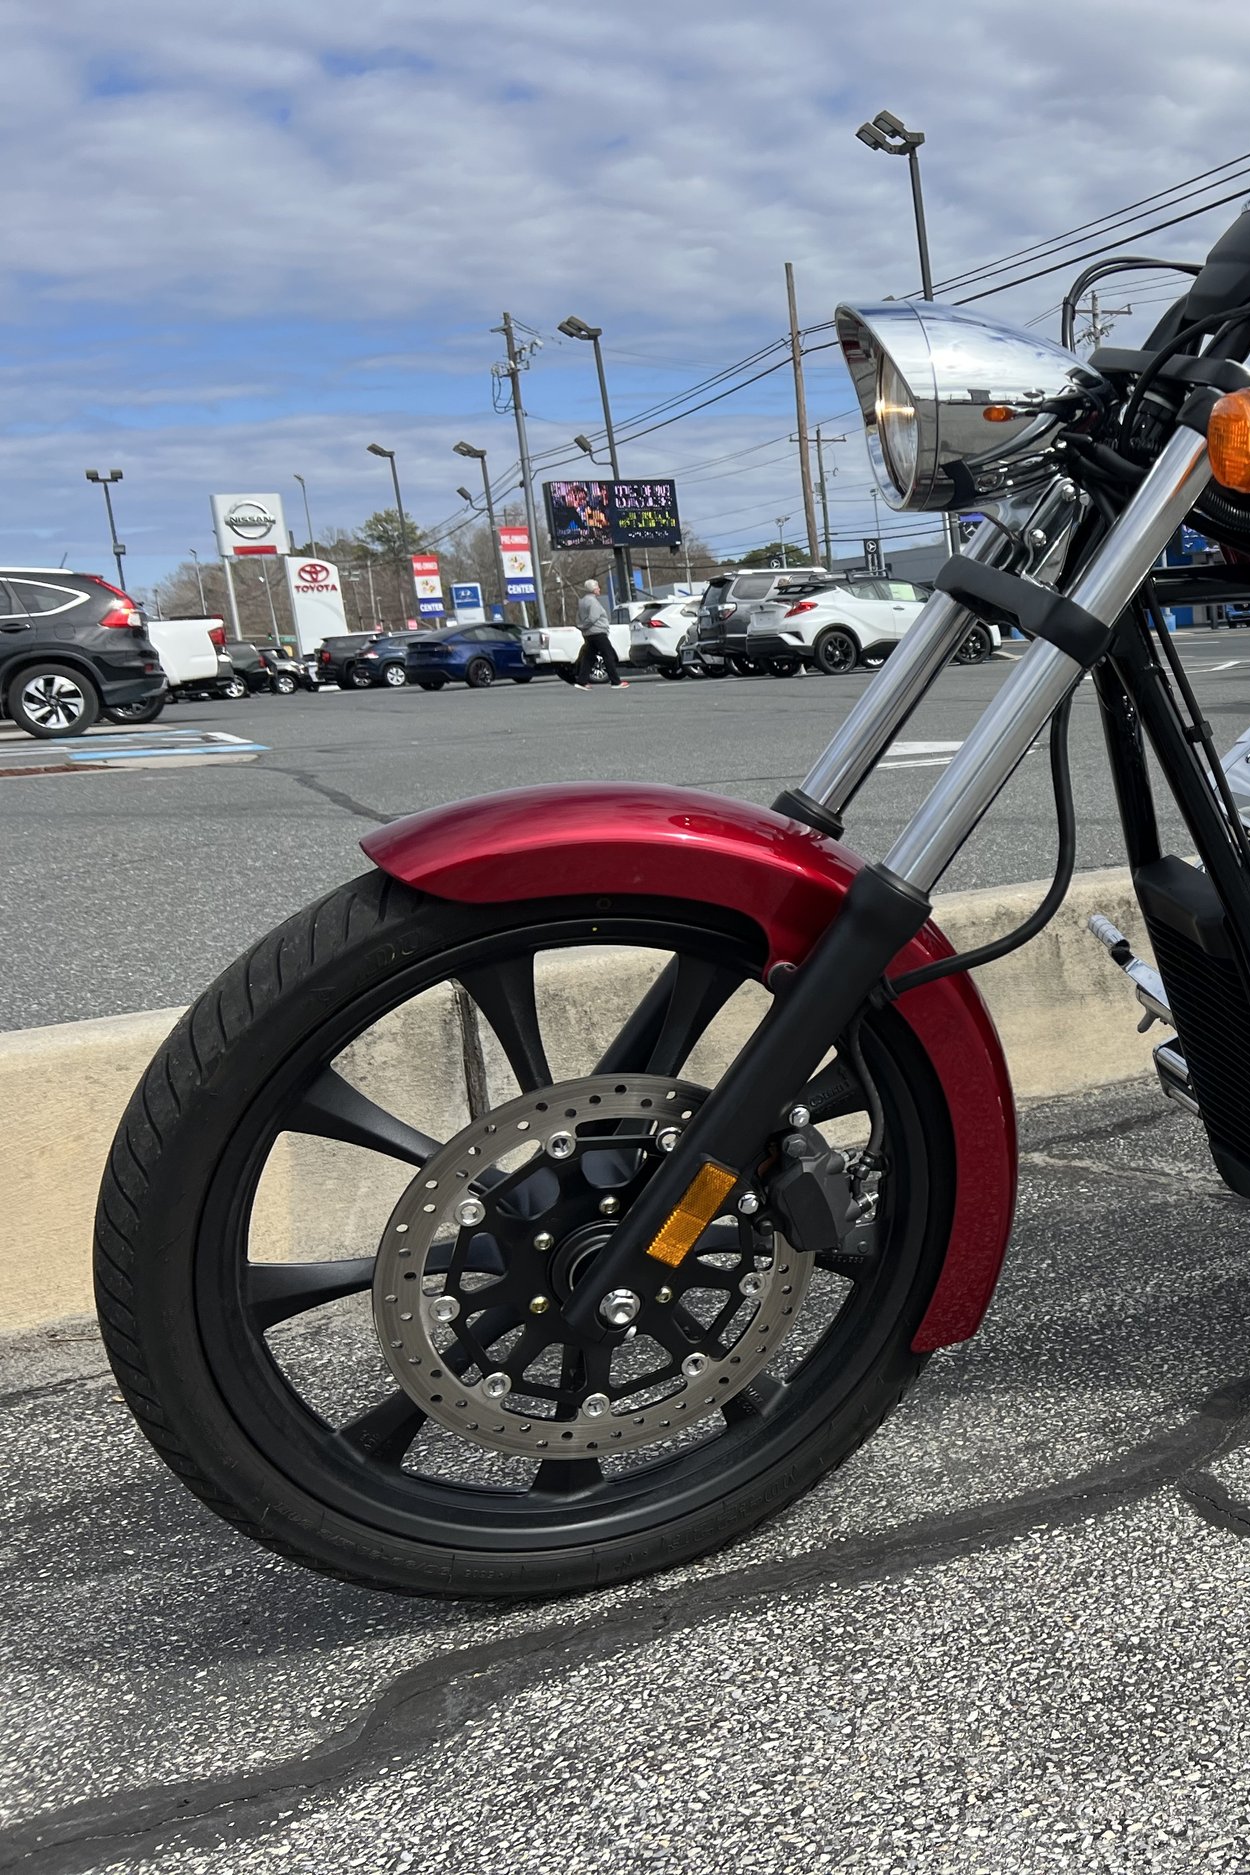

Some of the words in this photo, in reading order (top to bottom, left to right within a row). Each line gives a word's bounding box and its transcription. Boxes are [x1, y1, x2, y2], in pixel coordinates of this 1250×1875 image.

[230, 516, 272, 524] NISSAN
[294, 584, 338, 593] TOYOTA
[507, 584, 535, 595] CENTER
[419, 603, 444, 612] CENTER
